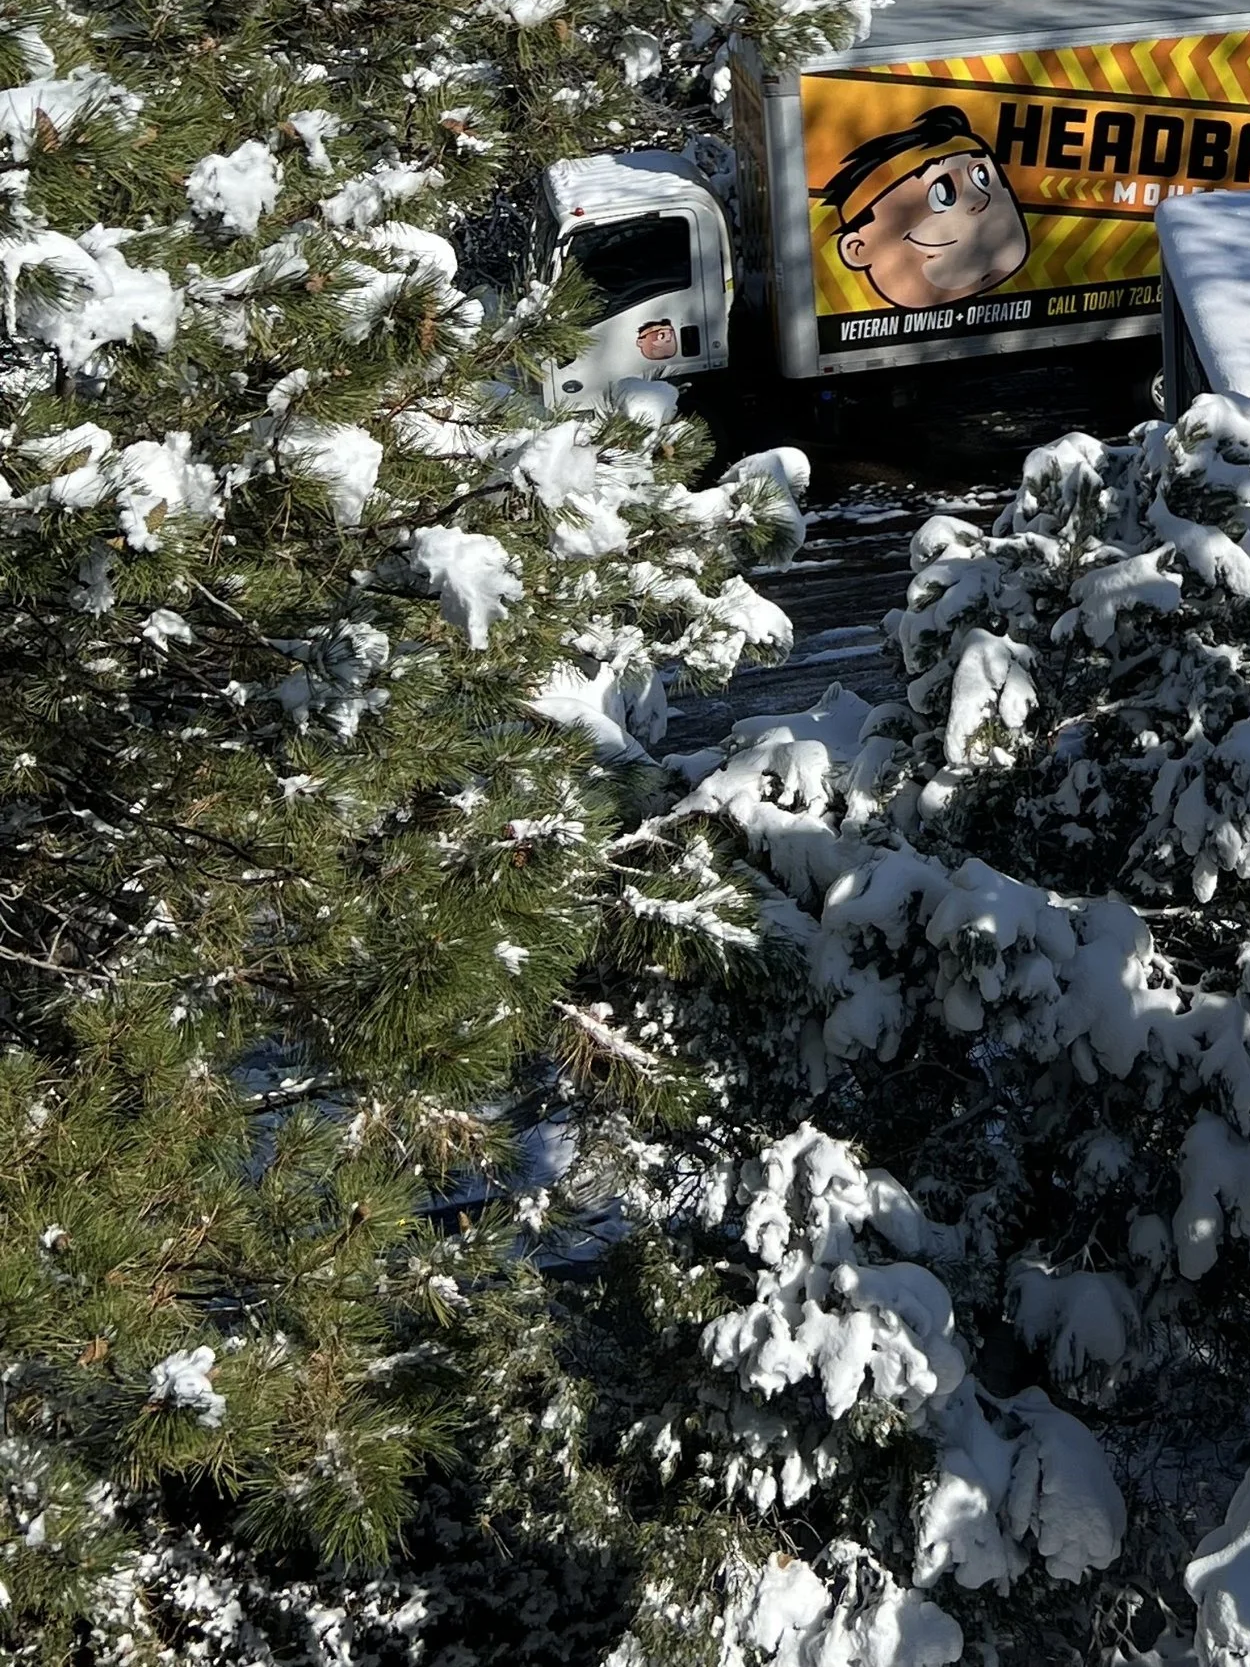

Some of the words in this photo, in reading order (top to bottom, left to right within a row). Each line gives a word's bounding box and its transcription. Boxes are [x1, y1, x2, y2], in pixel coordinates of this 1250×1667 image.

[841, 315, 900, 341] VETERAN
[903, 309, 954, 333] OWNED
[966, 299, 1032, 325] OPERATED
[1047, 295, 1078, 316] CALL
[1083, 289, 1125, 312] TODAY
